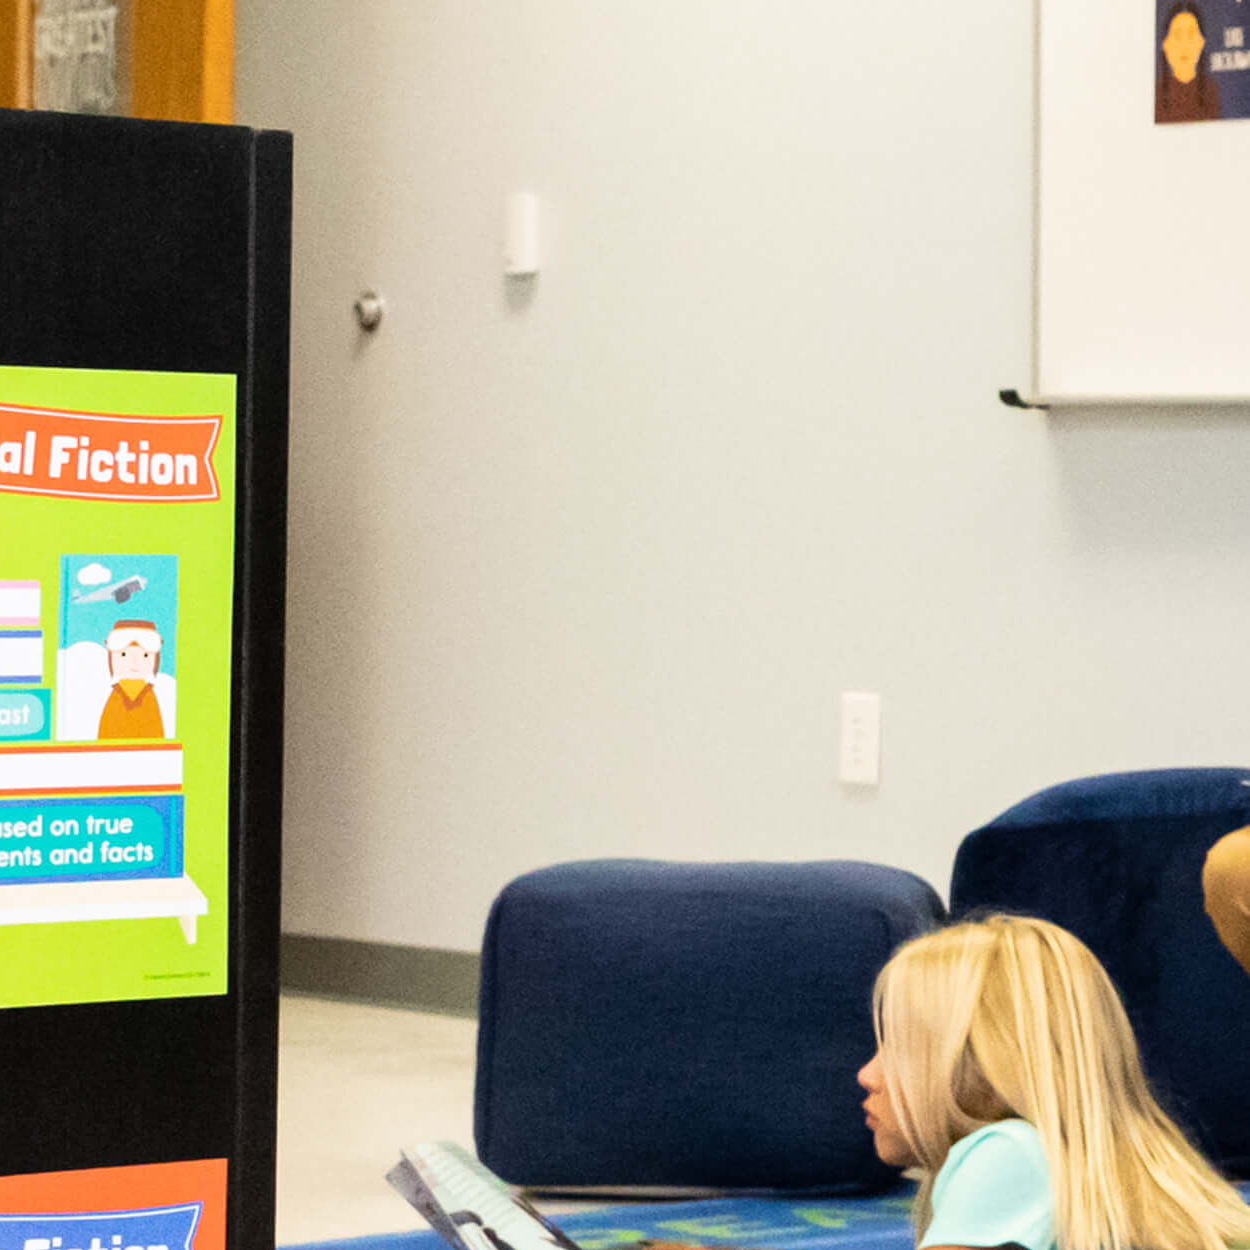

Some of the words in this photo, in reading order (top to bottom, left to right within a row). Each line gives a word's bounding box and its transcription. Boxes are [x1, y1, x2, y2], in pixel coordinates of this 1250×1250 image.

[49, 436, 198, 485] Fiction
[50, 820, 79, 836] on
[87, 816, 133, 834] true
[50, 843, 93, 865] and
[100, 842, 153, 863] facts
